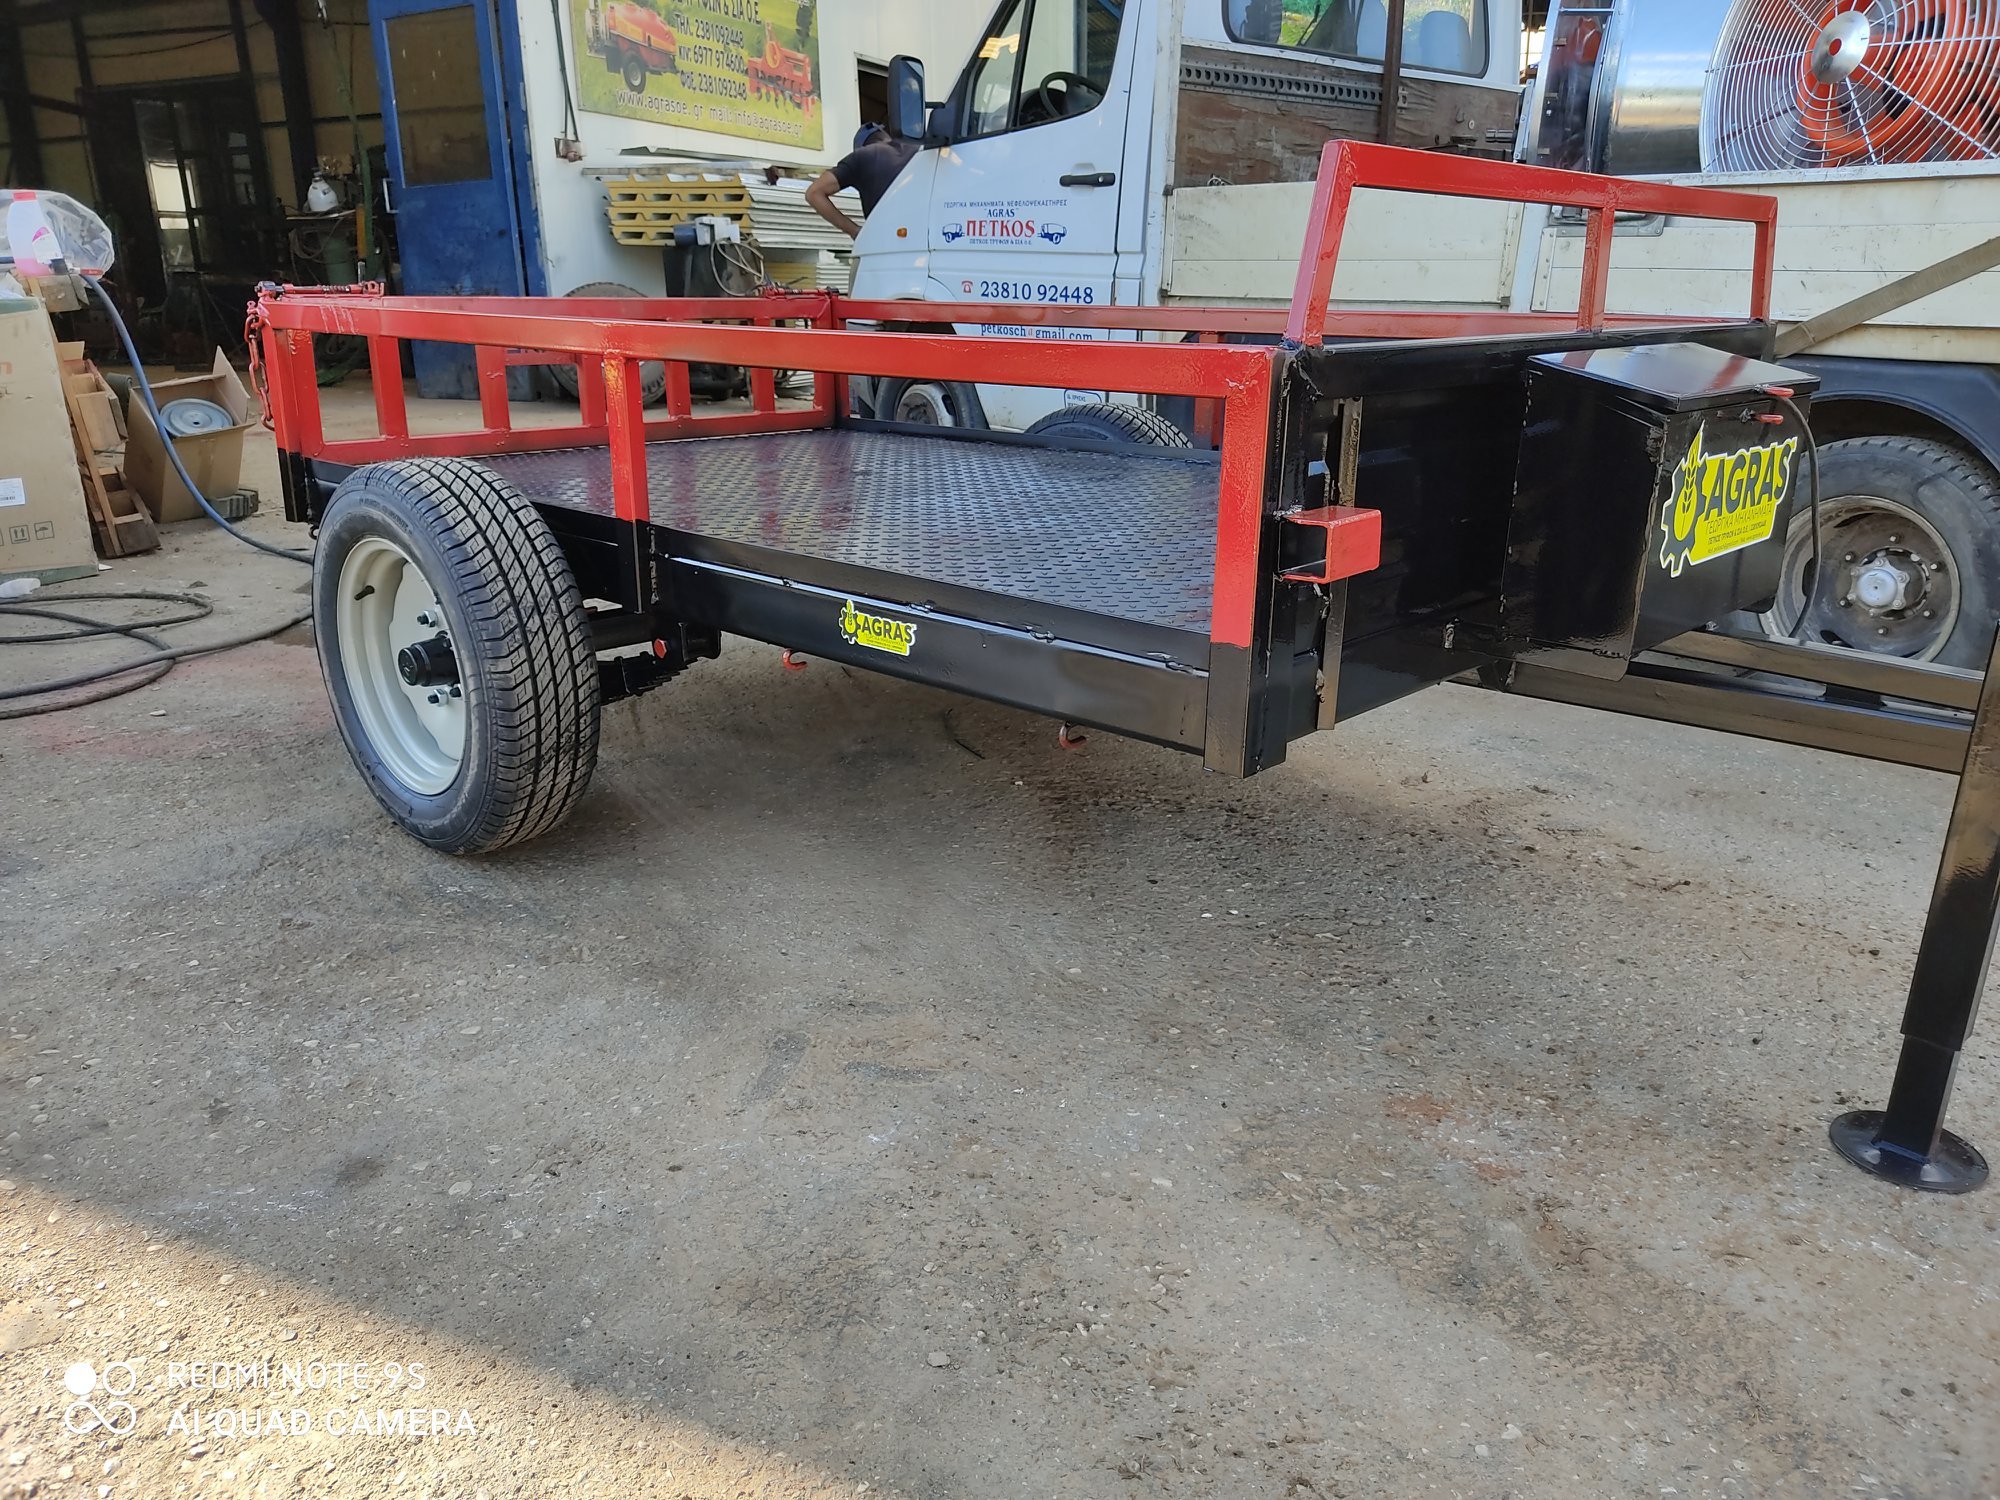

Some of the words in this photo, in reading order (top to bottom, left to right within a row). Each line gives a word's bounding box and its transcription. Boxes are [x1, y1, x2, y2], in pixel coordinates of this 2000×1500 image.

[695, 18, 744, 49] 2381092448
[693, 44, 713, 67] 6977
[980, 280, 1032, 300] 23810
[1037, 284, 1094, 304] 92448
[1704, 443, 1792, 521] AGRAS
[861, 615, 913, 644] AGRAS
